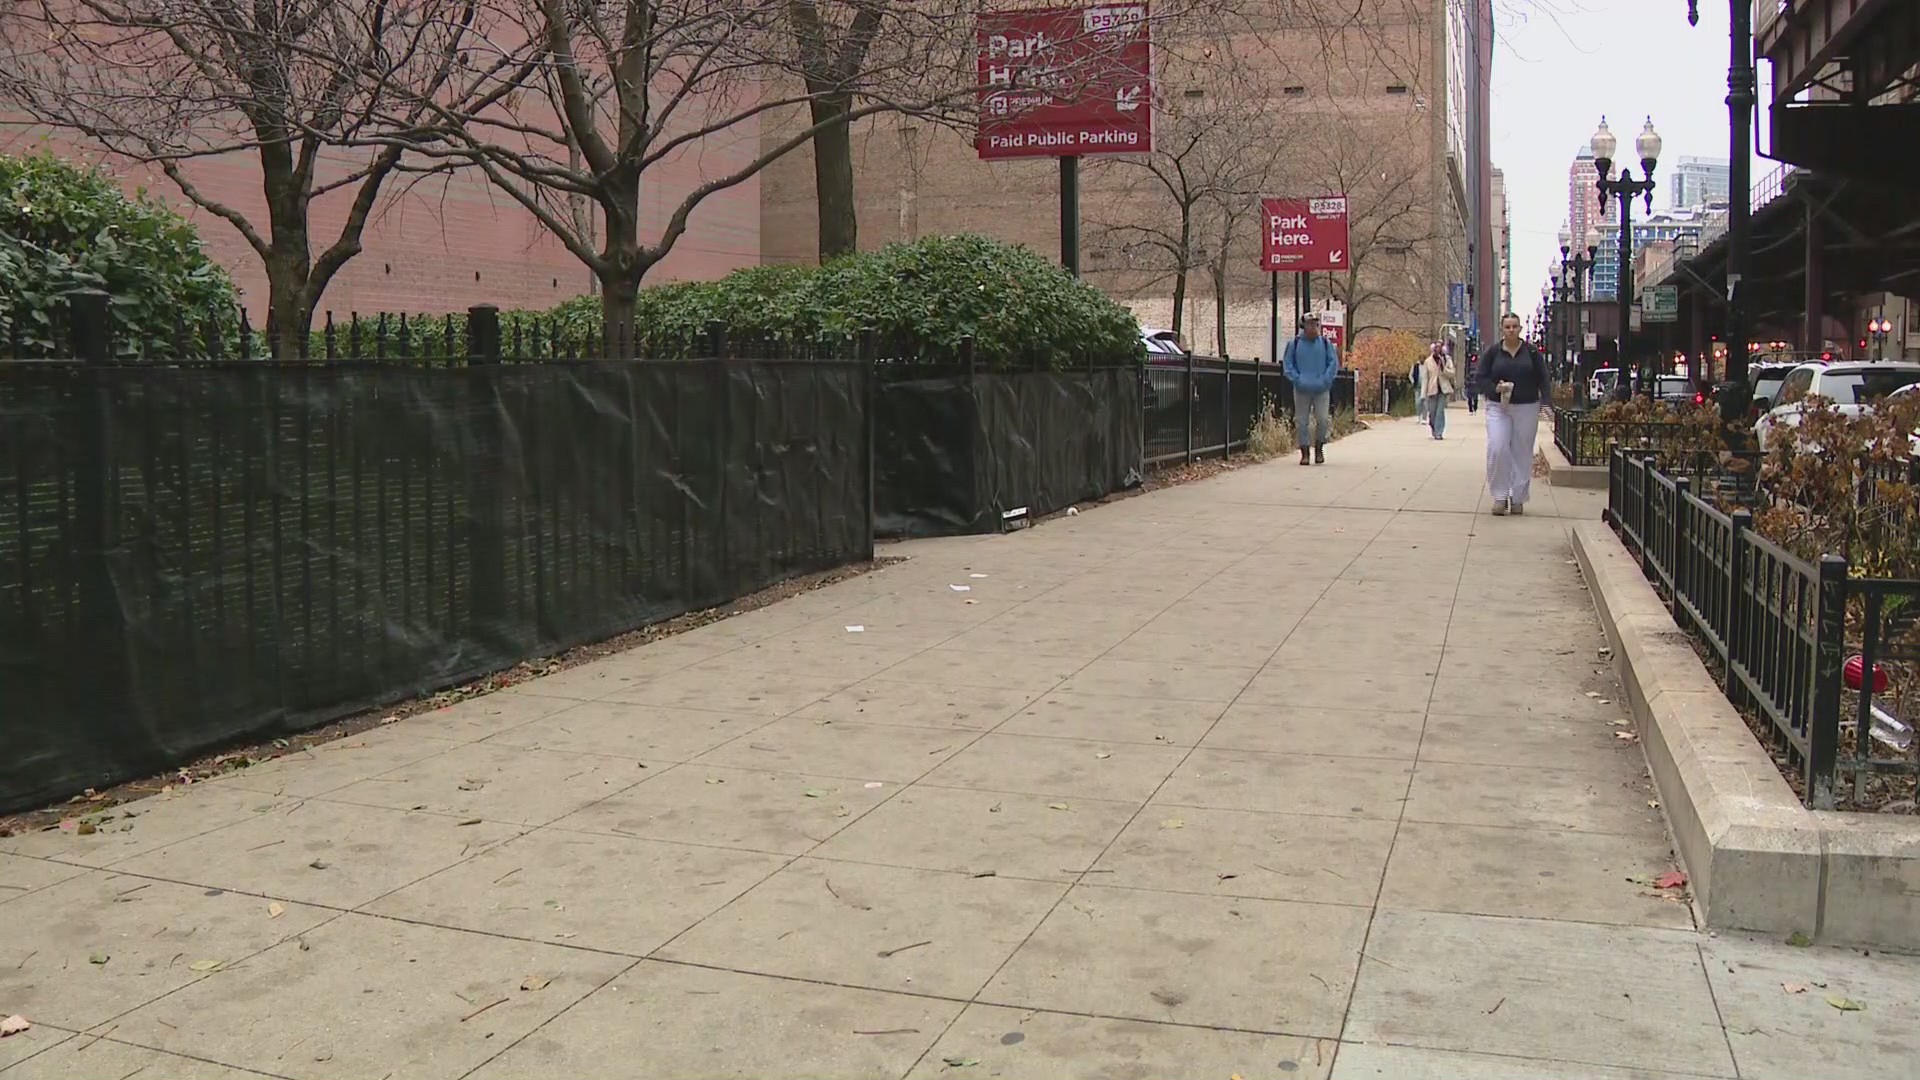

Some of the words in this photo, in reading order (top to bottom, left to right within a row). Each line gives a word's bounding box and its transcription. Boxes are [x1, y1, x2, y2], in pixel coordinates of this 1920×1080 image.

[989, 32, 1055, 59] Park
[990, 134, 1023, 148] Paid
[1027, 132, 1075, 147] Public
[1079, 130, 1138, 146] Parking
[1314, 201, 1342, 211] P5328
[1271, 214, 1307, 229] Park
[1271, 231, 1314, 246] Here.
[1322, 327, 1338, 339] Park
